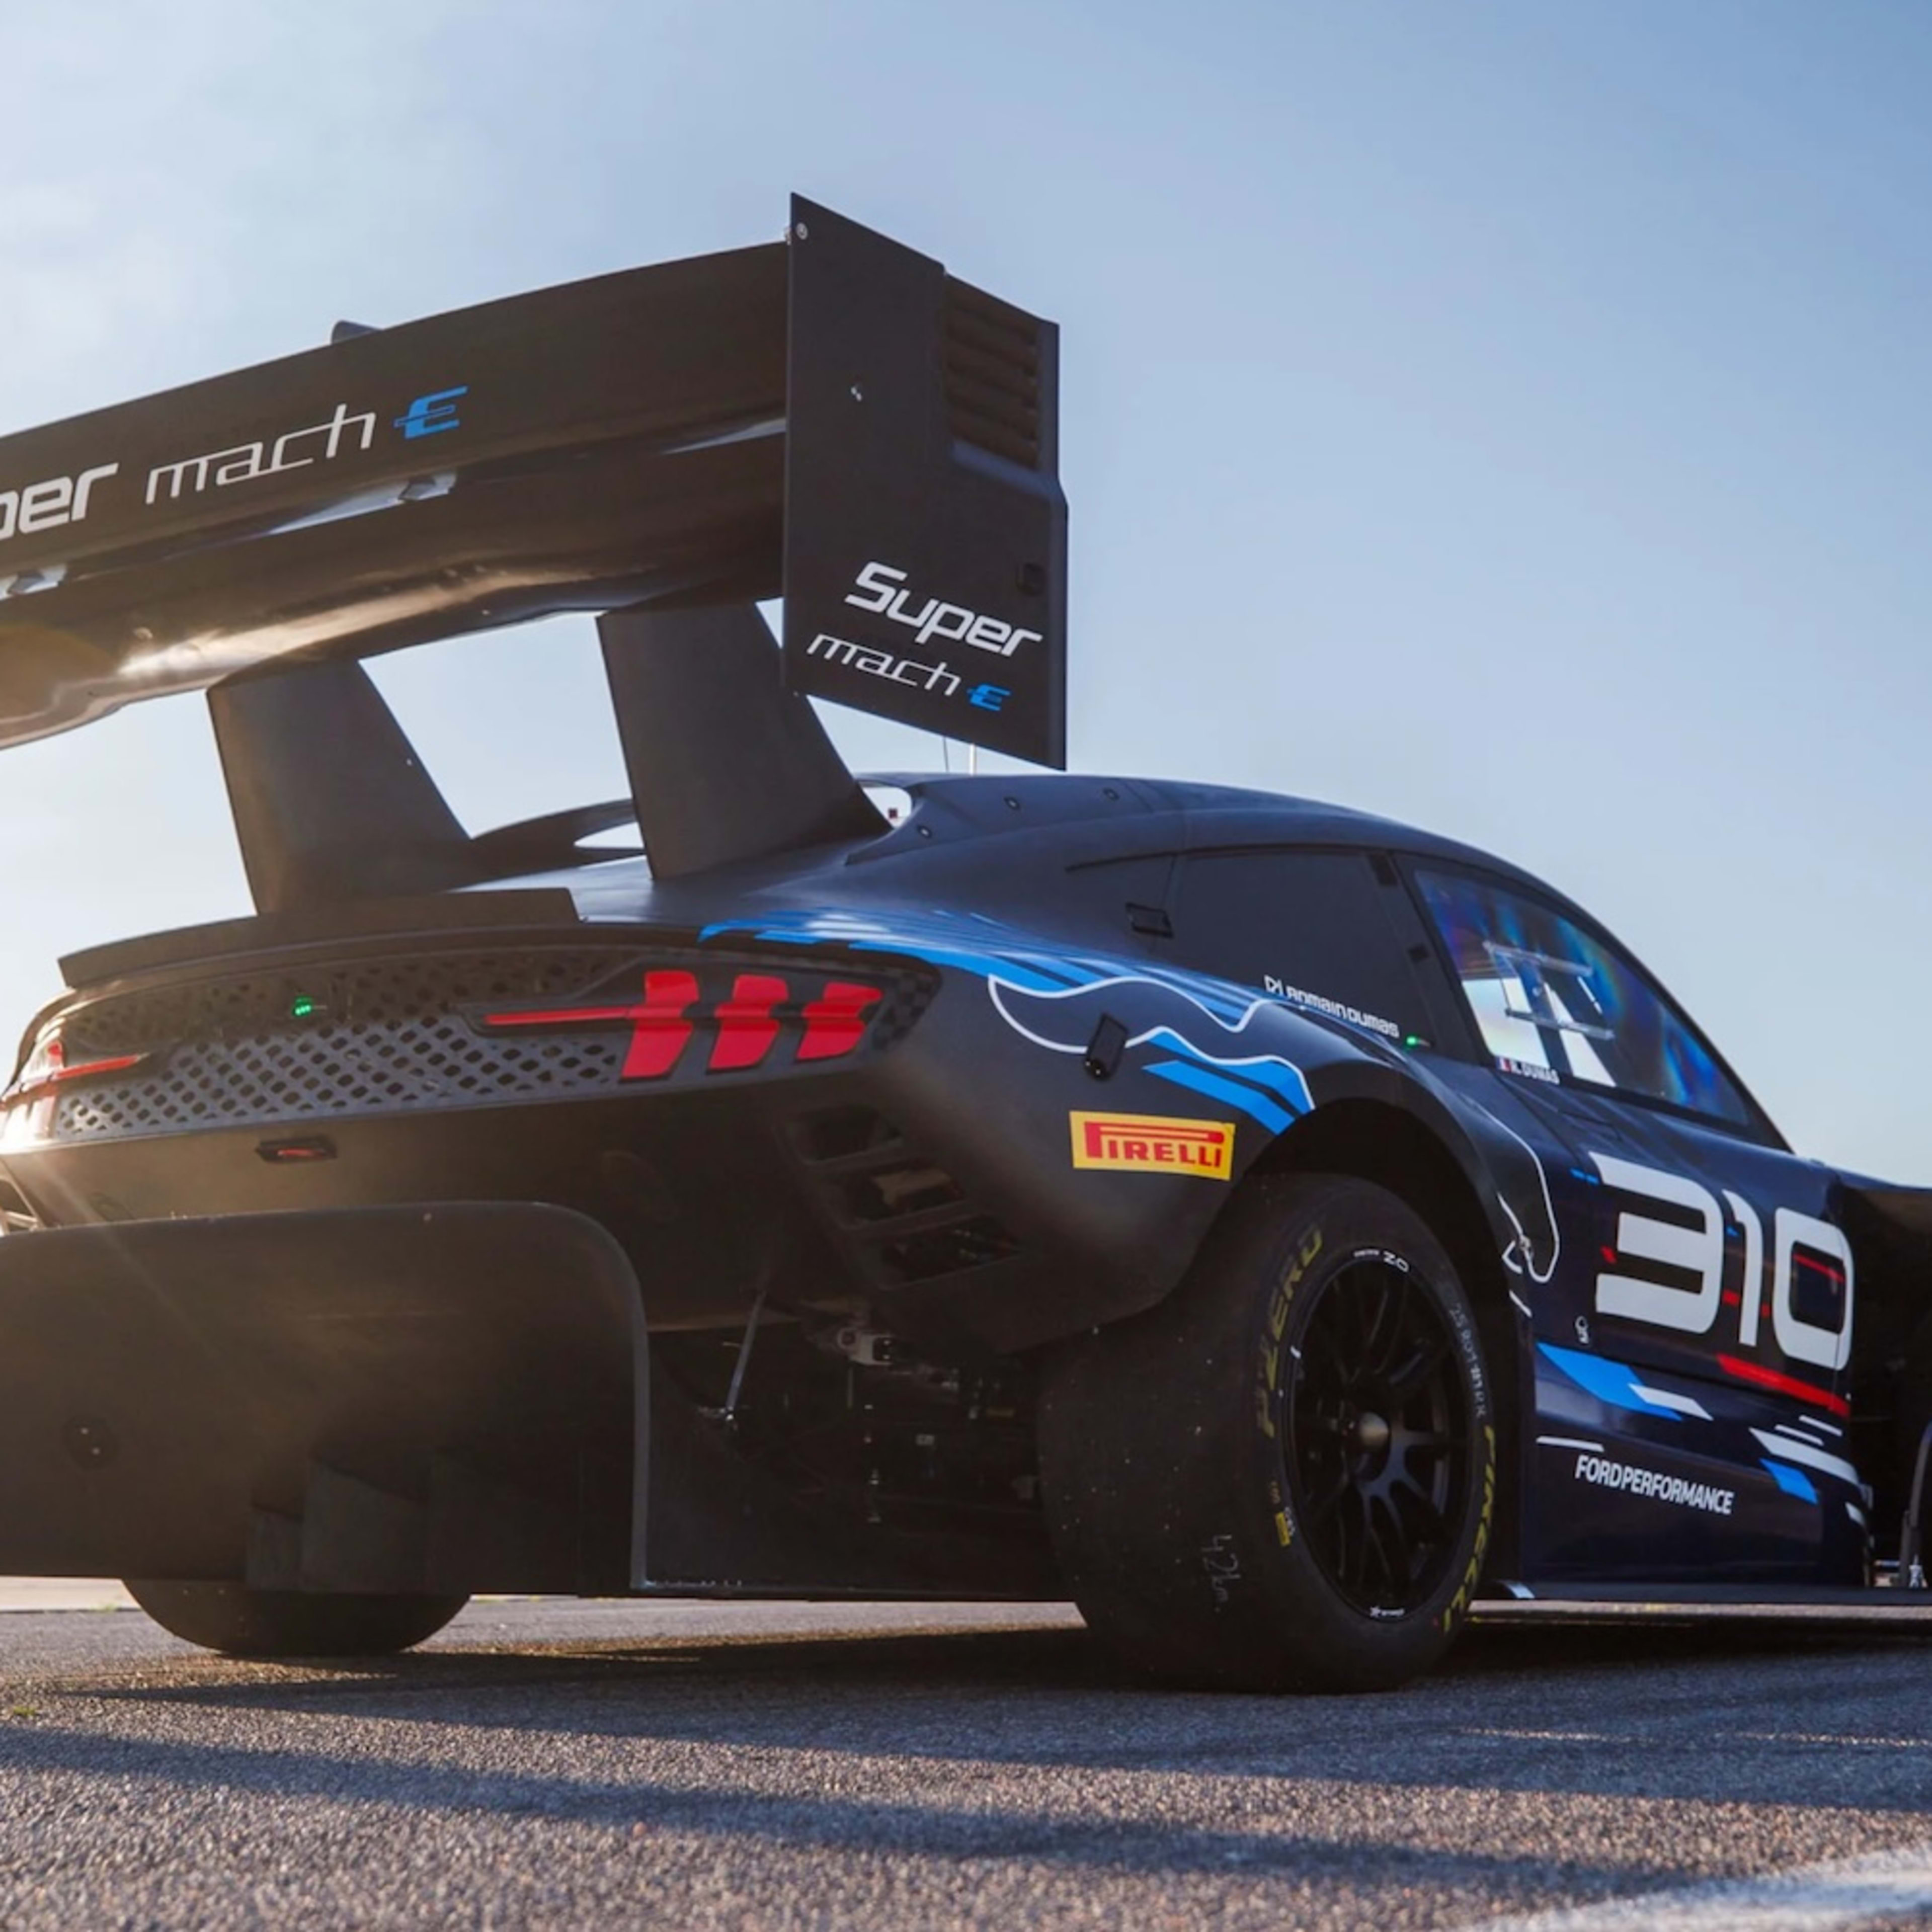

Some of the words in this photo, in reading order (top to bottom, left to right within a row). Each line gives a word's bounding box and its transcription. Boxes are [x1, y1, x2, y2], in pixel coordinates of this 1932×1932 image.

[145, 403, 376, 504] mach
[844, 561, 1043, 657] Super
[806, 633, 961, 696] mach
[1084, 1121, 1224, 1168] PIRELLI
[1589, 1151, 1854, 1371] 310
